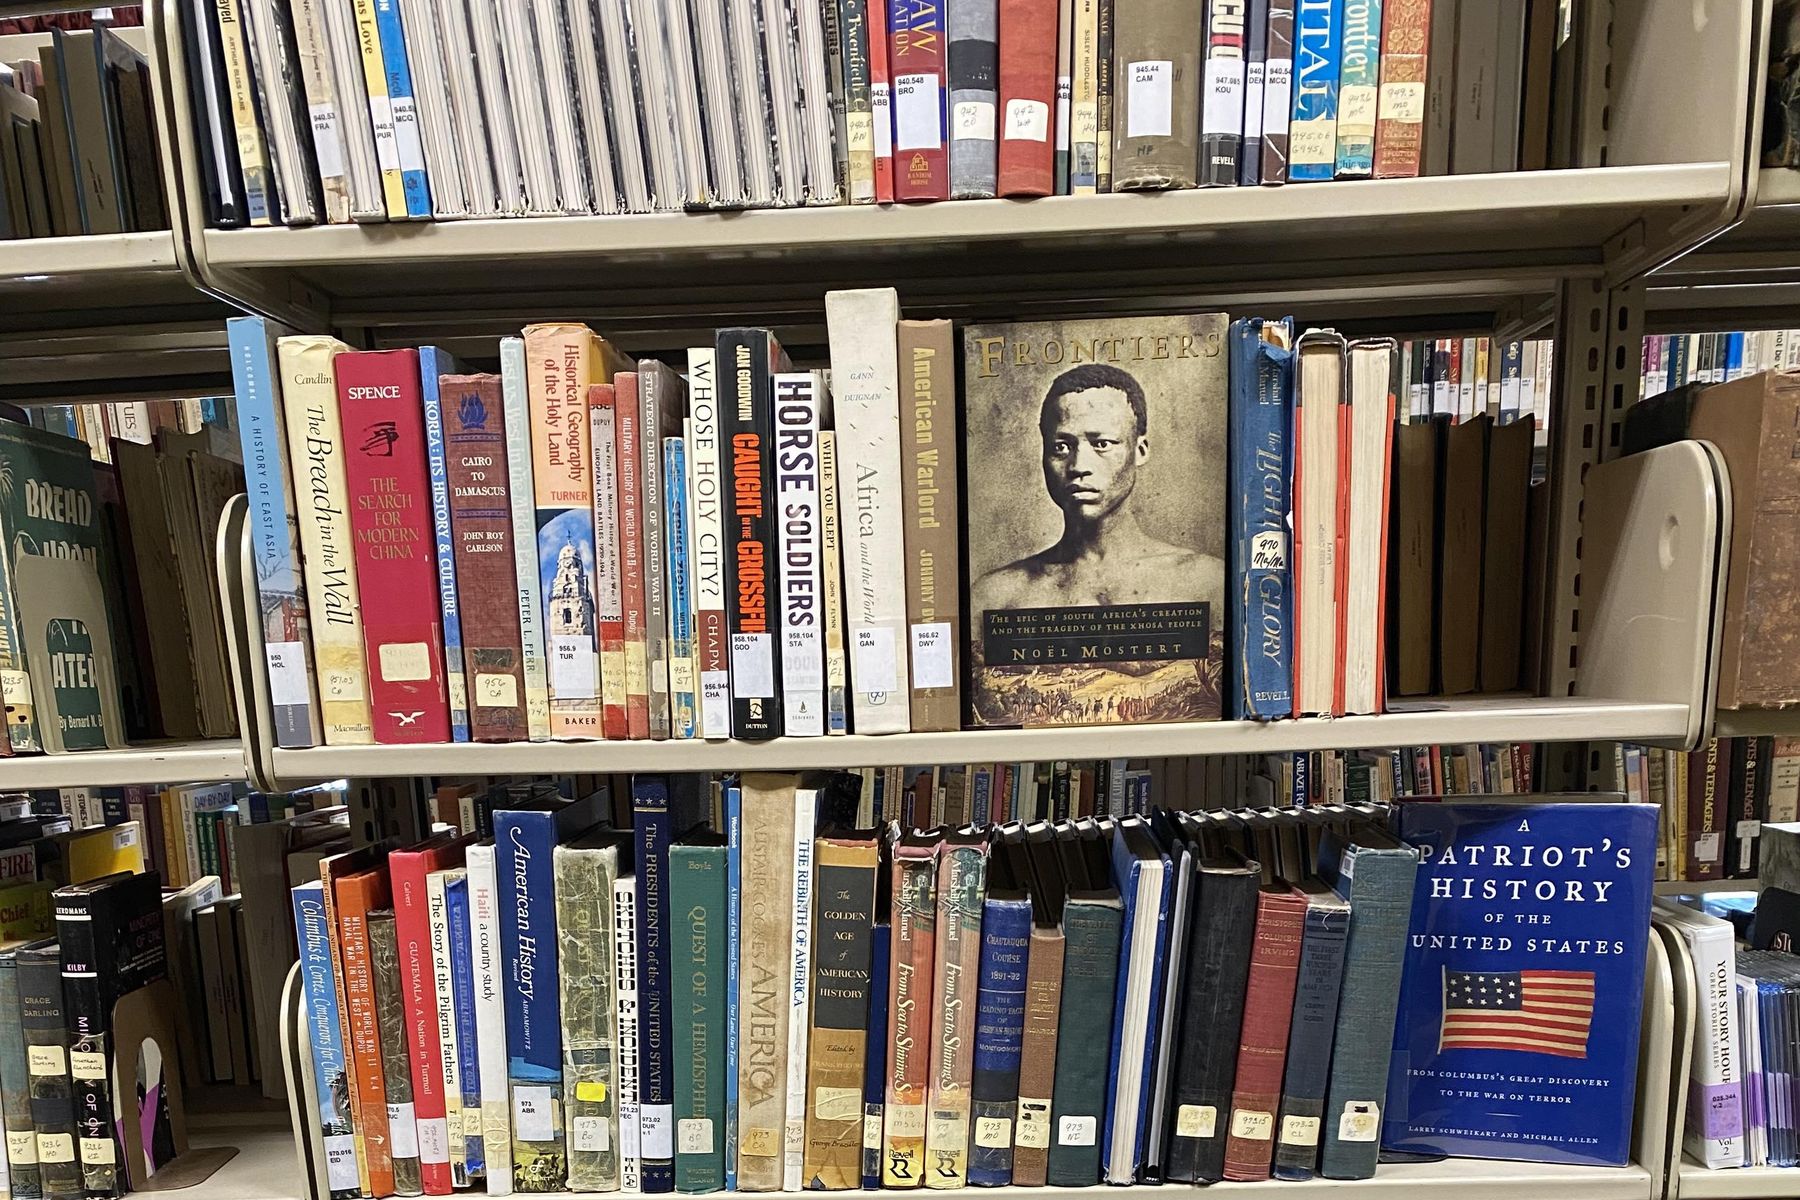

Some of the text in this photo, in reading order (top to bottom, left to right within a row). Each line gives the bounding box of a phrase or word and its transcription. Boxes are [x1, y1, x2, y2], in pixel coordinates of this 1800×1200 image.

[361, 22, 374, 55] Love
[1135, 75, 1153, 83] CAM
[1211, 156, 1235, 166] REVELL
[294, 373, 332, 385] Candlin
[736, 344, 754, 422] JAN GOODWIN
[348, 386, 400, 400] SPENCE
[543, 359, 564, 467] of the Holy Land
[564, 344, 583, 483] Historical Geography
[913, 347, 941, 529] American Warlord
[461, 457, 492, 468] CAIRO
[471, 471, 485, 482] TO
[693, 359, 721, 596] WHOSE HOLY CITY?
[370, 478, 399, 492] THE
[455, 485, 506, 497] DAMASCUS
[25, 478, 92, 527] BREAD
[358, 494, 413, 509] SEARCH
[550, 491, 588, 501] TURNER
[777, 380, 814, 627] HORSE SOLDIERS
[306, 404, 354, 627] The Breach in the Wall
[375, 511, 402, 526] FOR
[358, 528, 419, 543] MODERN
[463, 531, 504, 541] JOHN ROY
[370, 544, 414, 559] CHINA
[465, 543, 503, 553] CARLSON
[734, 643, 750, 651] GOO
[1082, 642, 1182, 658] MOSTERT
[565, 717, 596, 725] BAKER
[1517, 819, 1530, 831] A
[1417, 839, 1632, 869] PATRIOT'S
[837, 890, 850, 900] The
[1430, 877, 1613, 903] HISTORY
[476, 888, 490, 921] Haiti
[510, 825, 535, 999] American History
[824, 910, 866, 921] GOLDEN
[1484, 913, 1552, 924] OF THE
[793, 838, 811, 1008] THE REBIRTH OF AMERICA
[833, 932, 854, 941] AGE
[1412, 934, 1625, 954] UNITED STATES
[479, 932, 495, 974] country
[839, 950, 849, 959] of
[67, 964, 86, 972] KILBY
[817, 969, 869, 979] AMERICAN
[1716, 959, 1728, 999] YOUR
[482, 975, 496, 1001] study
[820, 988, 864, 999] HISTORY
[25, 997, 51, 1005] GRACE
[24, 1009, 59, 1017] DARLING
[1718, 1000, 1730, 1041] STORY
